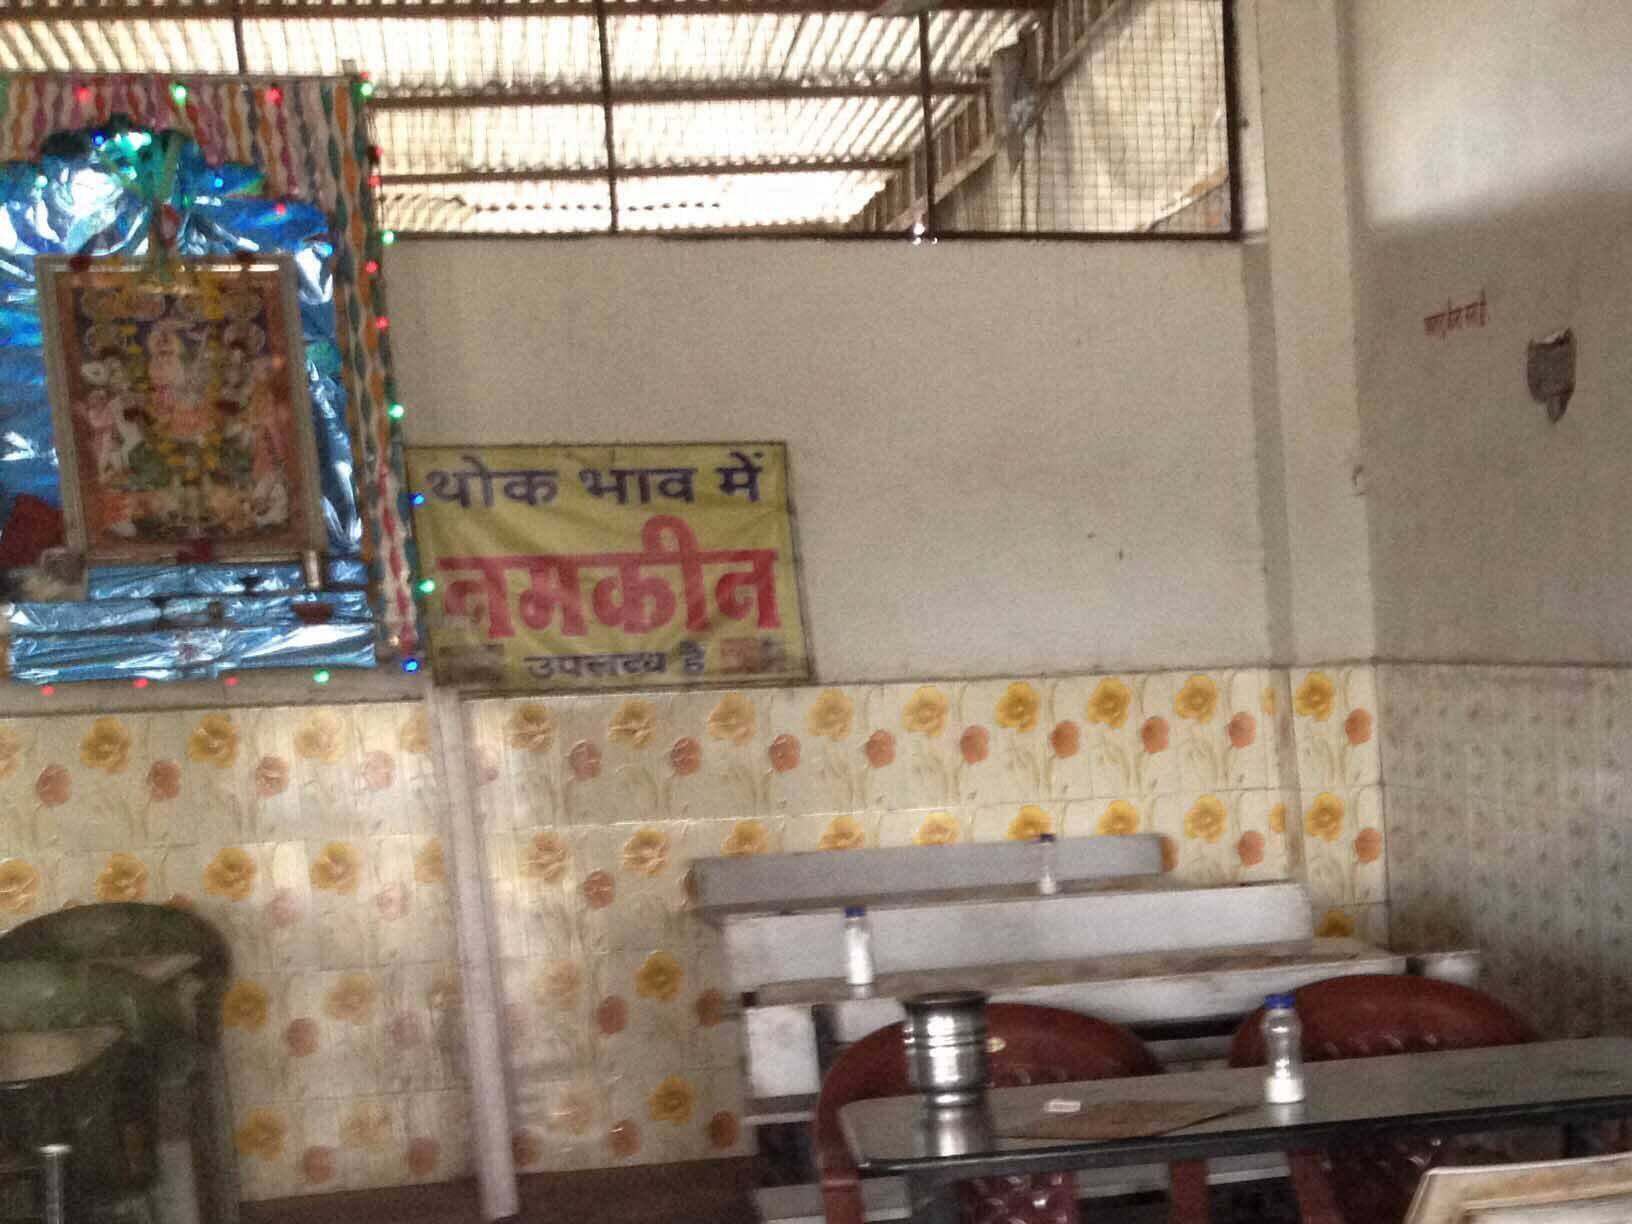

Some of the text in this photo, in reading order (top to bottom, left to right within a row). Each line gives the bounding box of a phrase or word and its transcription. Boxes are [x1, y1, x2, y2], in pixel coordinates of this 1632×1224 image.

[426, 452, 763, 508] थोक भाव में
[437, 514, 781, 638] नमकीन
